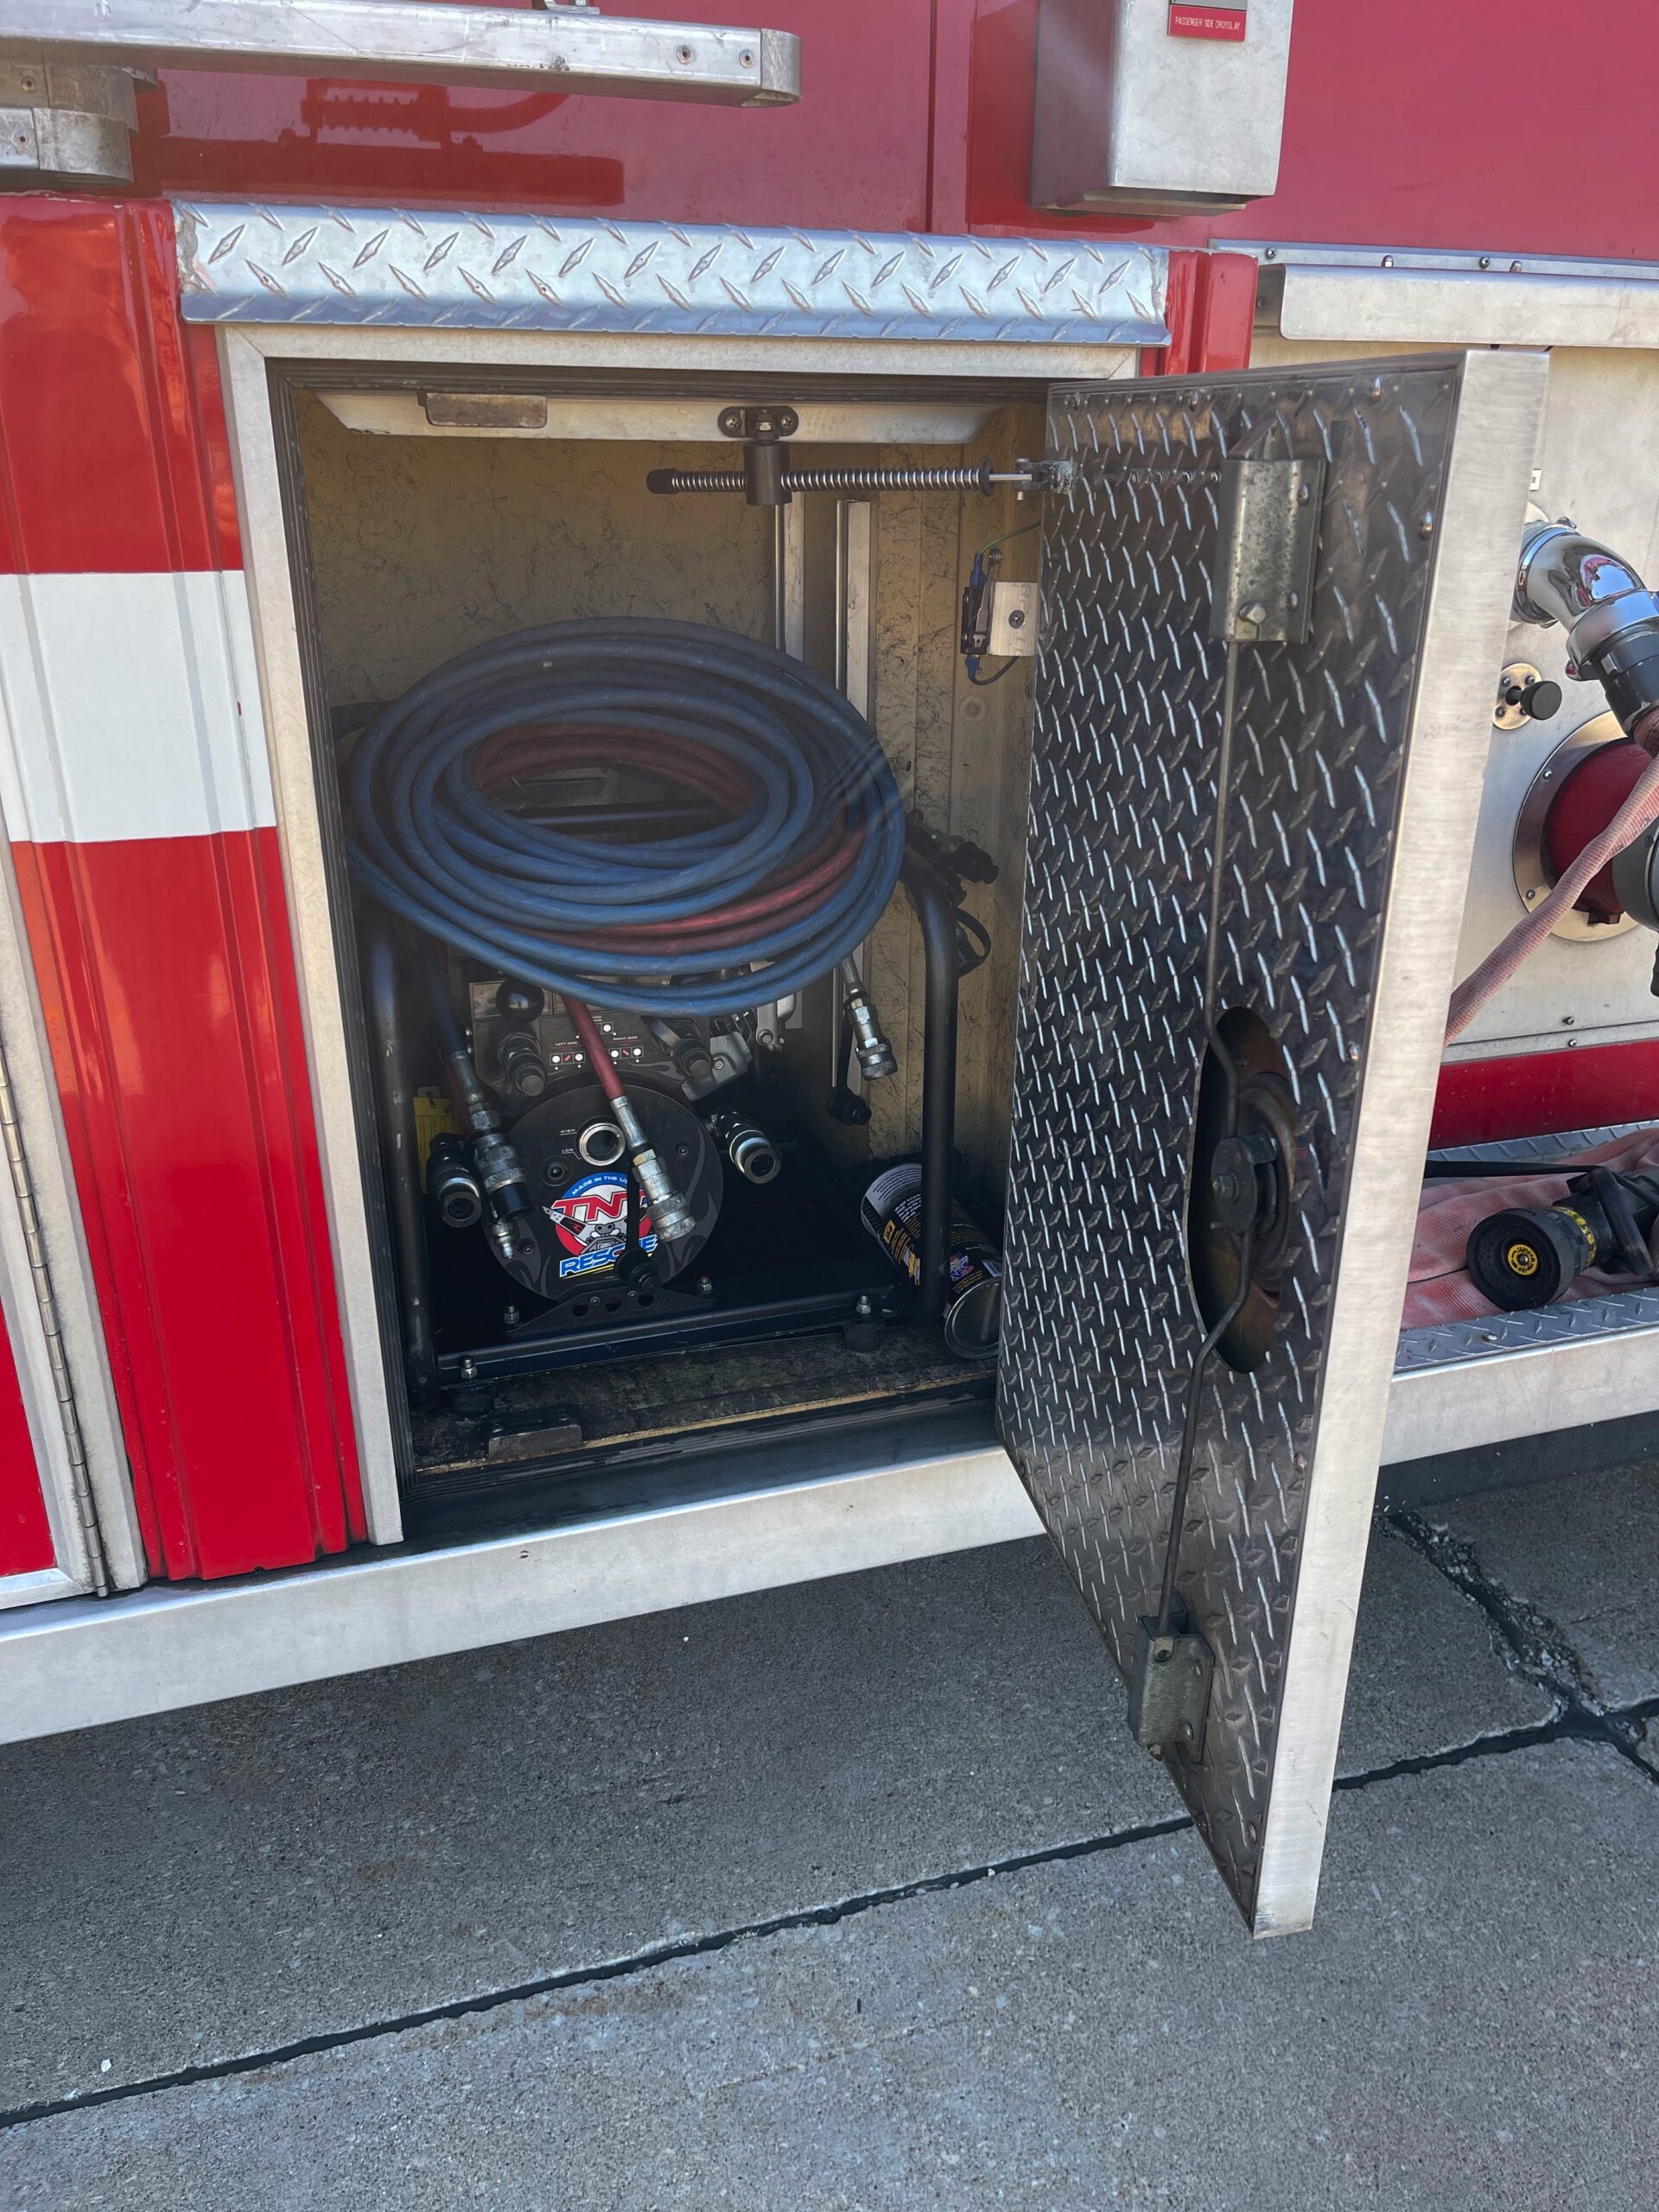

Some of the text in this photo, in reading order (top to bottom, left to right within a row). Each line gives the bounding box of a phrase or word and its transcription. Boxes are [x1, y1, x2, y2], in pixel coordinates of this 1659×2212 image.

[1175, 16, 1241, 30] PASSENGER SIDE CROSSLAY
[572, 1180, 593, 1196] MADE
[560, 1234, 658, 1278] RESCE
